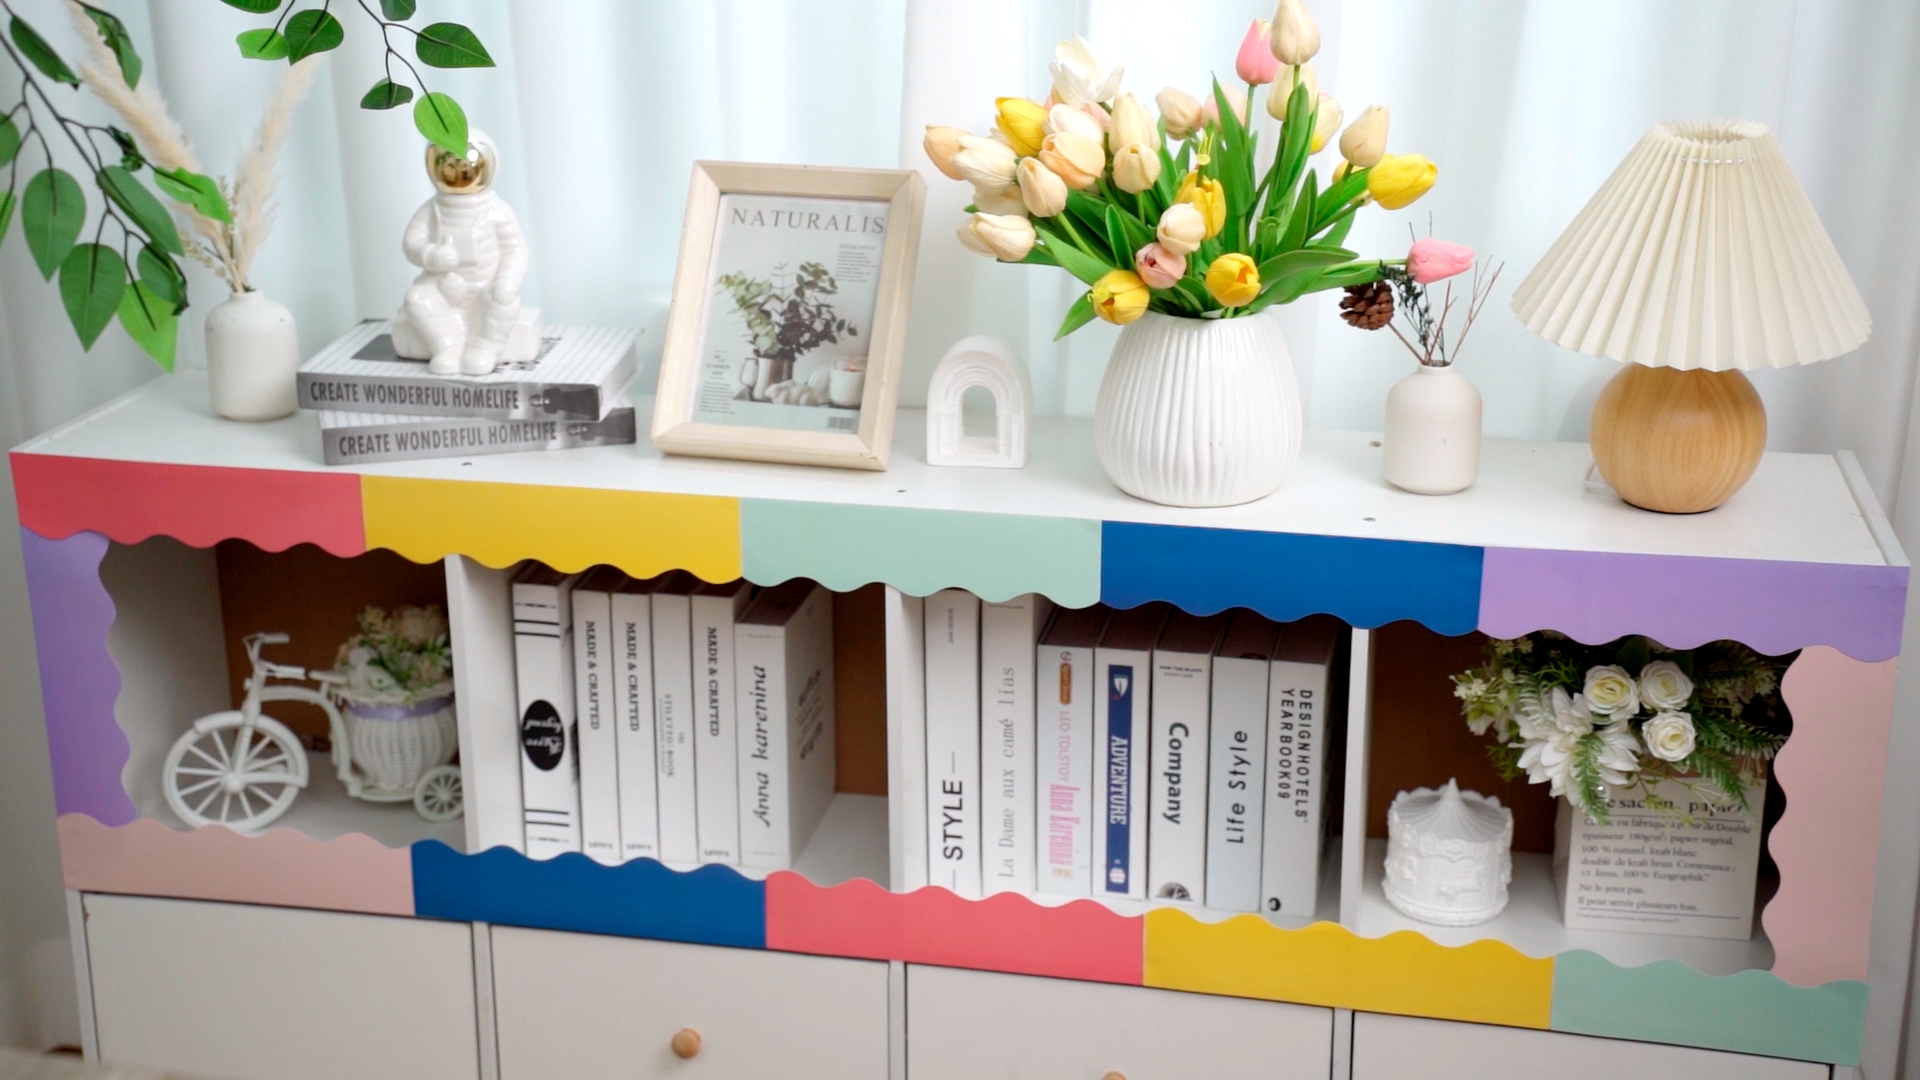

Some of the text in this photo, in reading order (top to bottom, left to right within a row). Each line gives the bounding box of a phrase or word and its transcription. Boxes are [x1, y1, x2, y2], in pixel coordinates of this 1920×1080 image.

[731, 208, 885, 234] NATURALIS
[310, 381, 520, 410] CREATE WONDERFUL HOMELIFE
[339, 420, 557, 456] CREATE WONDERFUL HOMELIFE
[585, 620, 600, 730] MADE & CRAFTED
[625, 622, 640, 732] MADE & CRAFTED
[707, 627, 720, 737] MADE & CRAFTED
[664, 693, 675, 778] STILETTO BOOK
[1059, 711, 1071, 733] LEO
[749, 665, 771, 828] Anna karenina
[1058, 734, 1071, 783] TOLSTOY
[1002, 774, 1015, 799] aux
[1109, 734, 1129, 826] ADVENTURE
[1162, 721, 1189, 826] Company
[1226, 730, 1251, 844] Life Style
[1050, 783, 1080, 812] Anna
[942, 779, 963, 862] STYLE
[998, 808, 1015, 849] Dame
[1716, 823, 1751, 834] Double
[1049, 814, 1080, 866] Karenina
[1582, 845, 1598, 854] 100
[1650, 846, 1671, 856] kraft
[1672, 847, 1698, 858] blanc
[1670, 835, 1699, 844] papier
[998, 858, 1015, 879] La
[1614, 857, 1626, 866] de
[1628, 858, 1648, 867] kraft
[1623, 870, 1640, 878] 100
[1580, 884, 1592, 892] Ne
[1594, 884, 1604, 892] le
[1586, 898, 1606, 906] peut
[1636, 900, 1678, 910] plusieurs
